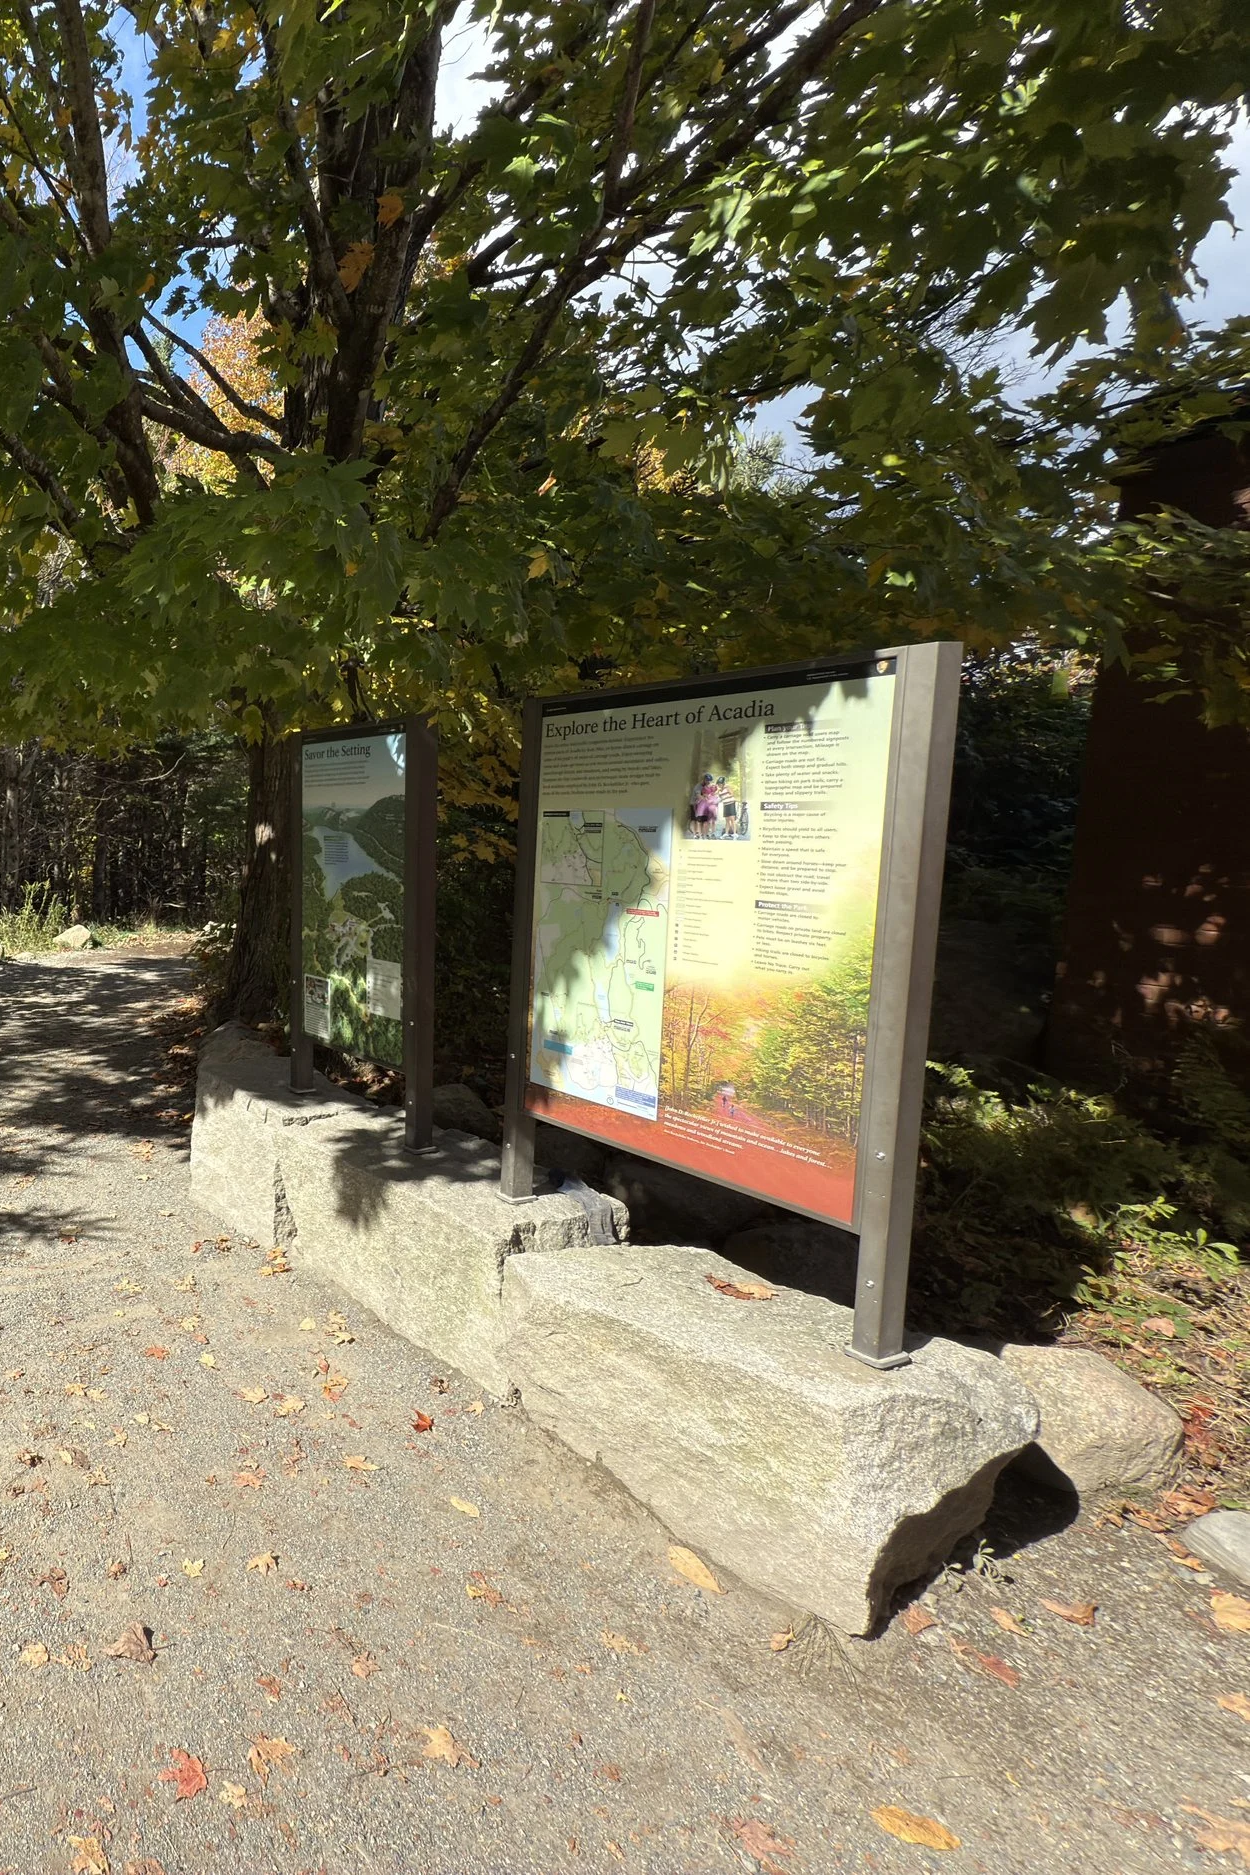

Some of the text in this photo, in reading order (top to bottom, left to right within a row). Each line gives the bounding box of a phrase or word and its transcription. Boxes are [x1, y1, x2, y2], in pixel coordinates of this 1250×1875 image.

[545, 700, 775, 740] Explore the Heart of Acadia
[304, 744, 371, 760] Savor the Setting
[663, 1121, 686, 1131] meadows
[696, 1131, 721, 1143] woodland
[673, 1117, 699, 1127] spectacular
[700, 1124, 714, 1132] views
[721, 1130, 746, 1142] mountain
[746, 1138, 758, 1146] and
[796, 1154, 808, 1162] and
[684, 1111, 710, 1122] Rockefeller
[720, 1122, 738, 1131] wished
[744, 1128, 760, 1138] make
[760, 1135, 786, 1146] available
[793, 1145, 821, 1157] everyone
